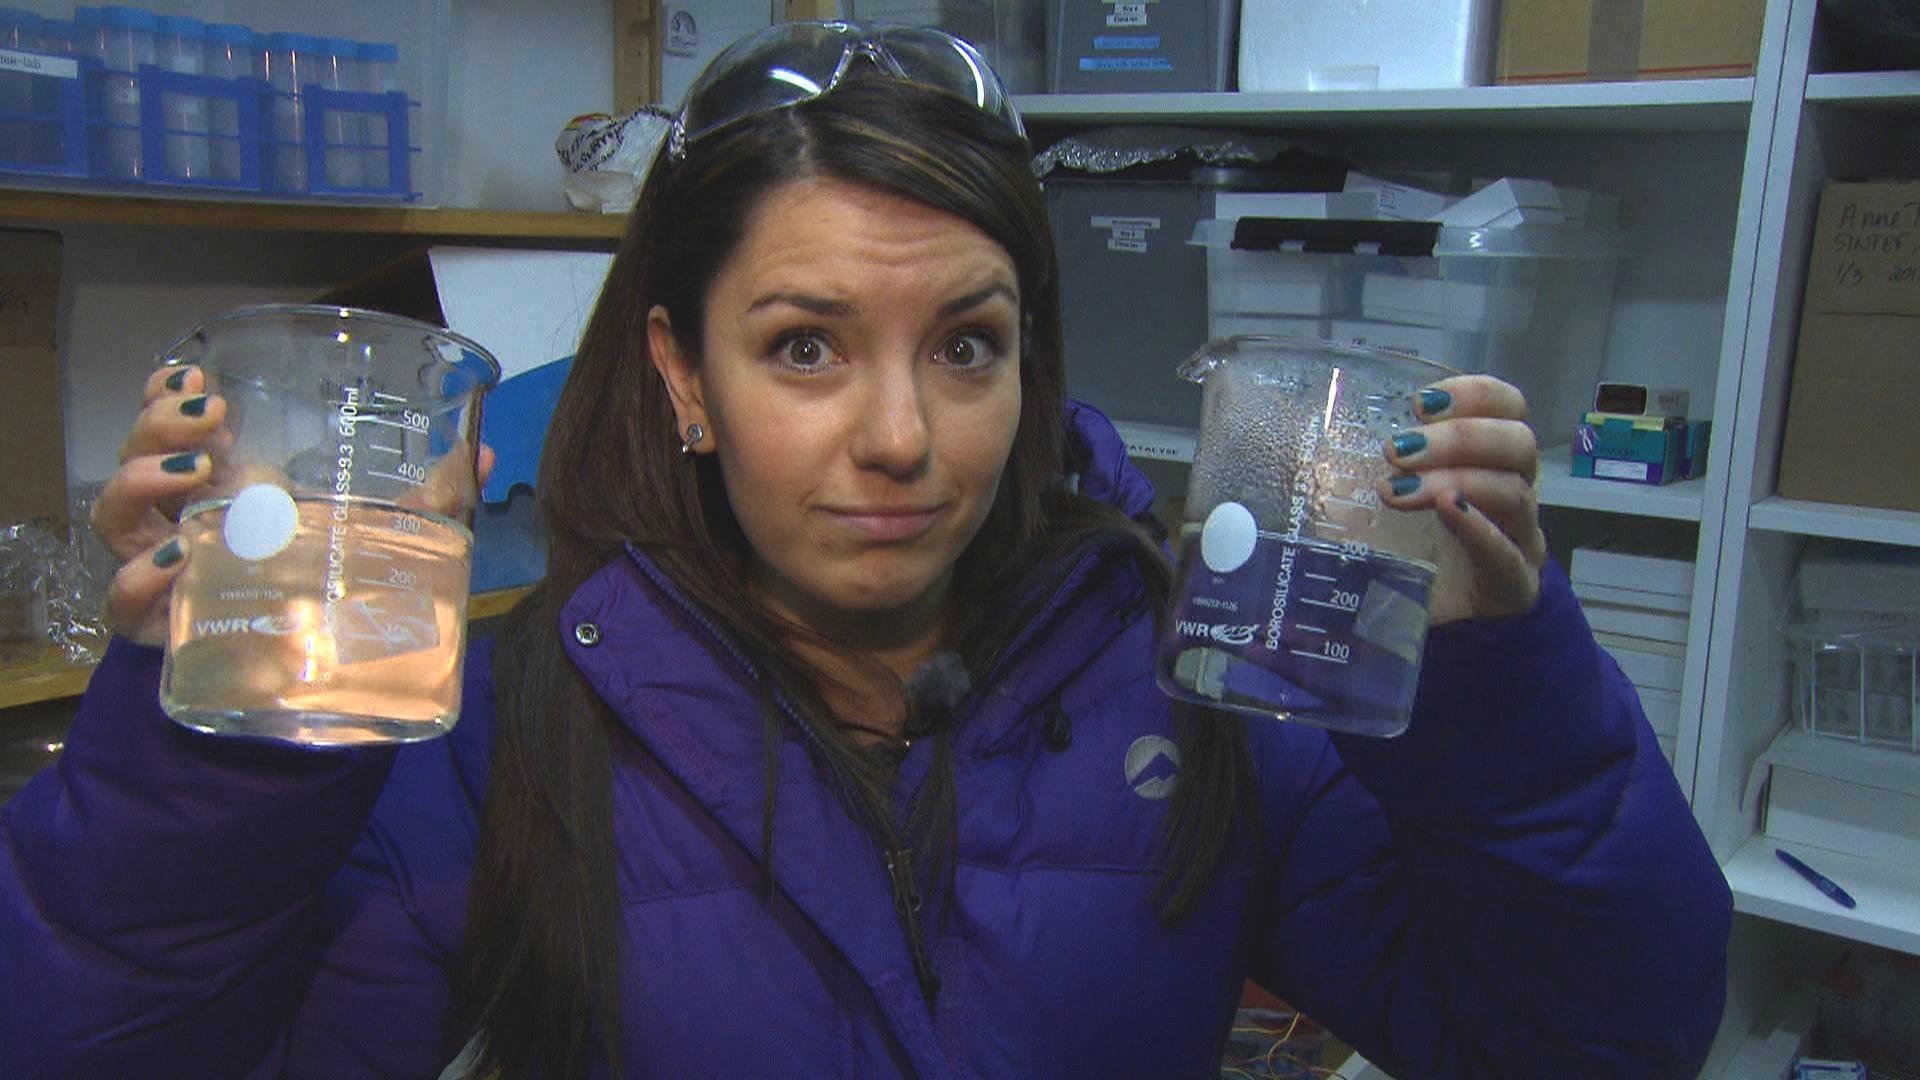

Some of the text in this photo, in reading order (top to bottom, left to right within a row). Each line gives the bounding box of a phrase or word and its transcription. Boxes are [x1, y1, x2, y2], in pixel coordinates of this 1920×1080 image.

[1833, 232, 1912, 255] SINTEF
[339, 387, 359, 437] 600ml
[403, 409, 430, 430] 500
[1129, 444, 1179, 457] ATALYSE
[398, 461, 425, 481] 400
[1351, 487, 1378, 507] 400
[392, 514, 421, 533] 300
[1341, 541, 1369, 556] 300
[387, 568, 416, 586] 200
[1265, 546, 1296, 651] BOROSILICATE
[1287, 495, 1305, 543] GLASS
[1330, 589, 1360, 608] 200
[194, 617, 249, 637] VWR
[1175, 619, 1209, 638] VWR
[1324, 640, 1350, 659] 100
